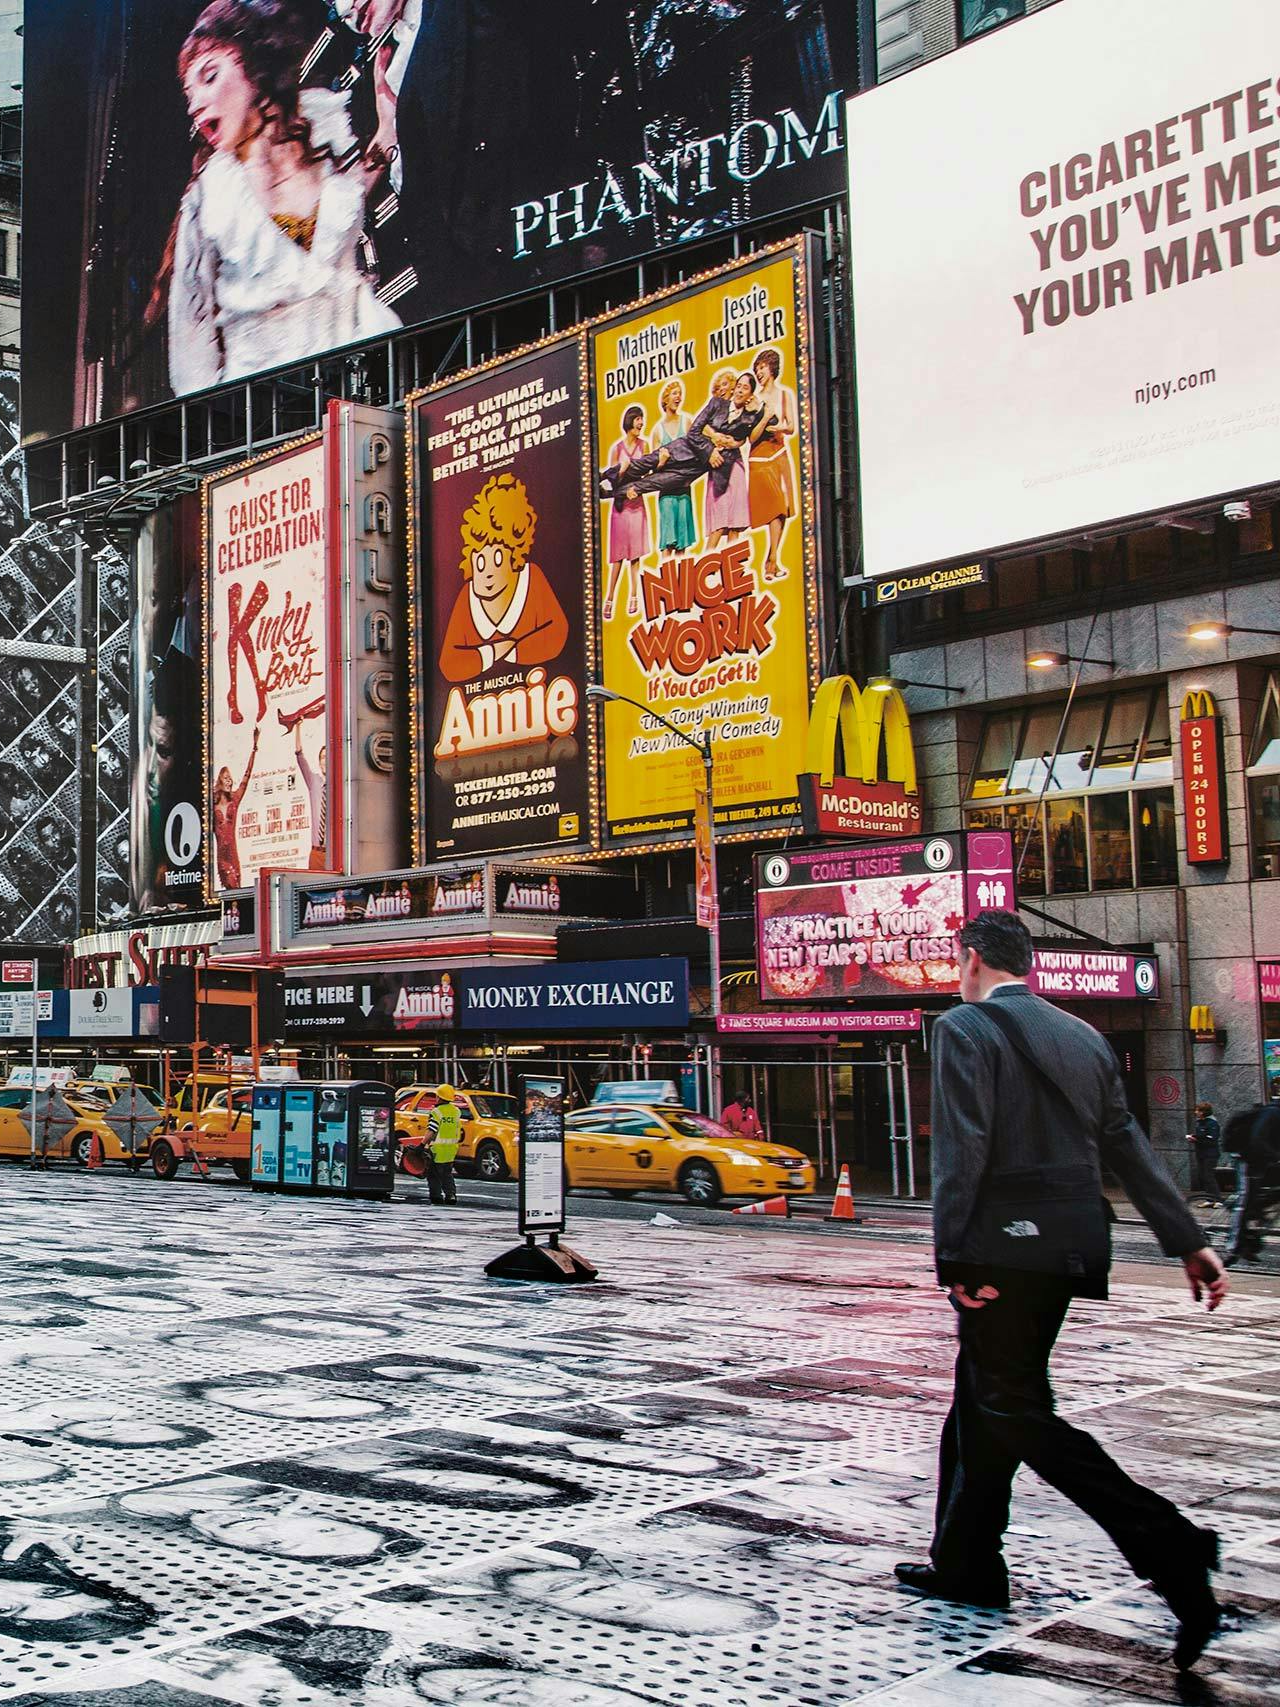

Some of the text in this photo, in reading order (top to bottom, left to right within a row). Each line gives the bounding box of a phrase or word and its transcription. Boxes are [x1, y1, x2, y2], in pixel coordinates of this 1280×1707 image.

[510, 89, 844, 260] PHANTOM
[1030, 172, 1192, 272] YOU'VE
[724, 286, 767, 329] Jessie
[1013, 256, 1132, 336] YOUR
[618, 322, 680, 363] Matthew
[709, 308, 785, 362] MUELLER
[605, 341, 696, 400] BRODERICK
[1134, 367, 1217, 405] njoy.com
[477, 378, 544, 416] ULTIMATE
[428, 386, 570, 451] FEEL-GOOD MUSICAL
[453, 414, 542, 458] IS BACK AND
[432, 454, 479, 482] BETTER
[481, 437, 520, 464] THAN
[229, 477, 311, 536] CAUSE FOR
[640, 540, 756, 621] NICE
[929, 574, 983, 591] SPECTACOLOR
[363, 432, 395, 774] PALACE
[227, 580, 313, 725] Kinky
[630, 594, 777, 677] WORK
[266, 643, 324, 693] Boots
[465, 672, 524, 694] THE MUSICAL
[648, 661, 758, 700] If You Can Get It
[434, 666, 579, 759] Annie
[641, 696, 769, 731] The Tony-Winning
[630, 716, 781, 758] New Musicl Comedy
[1191, 727, 1204, 775] OPEN
[454, 766, 557, 794] TICKETMASTER.COM
[1190, 778, 1209, 791] 24
[451, 802, 560, 829] ANNIETHEMUSICAL.COM
[455, 795, 469, 808] OR
[821, 794, 920, 820] McDonald's
[838, 817, 904, 832] Restaurant
[1194, 794, 1208, 855] HOURS
[164, 869, 202, 886] lifetime
[811, 857, 902, 881] COME INSIDE
[303, 898, 346, 926] Annie
[365, 890, 411, 919] Annie
[433, 881, 483, 914] Annie
[504, 882, 561, 912] Annie
[792, 909, 928, 941] PRACTICE YOUR
[767, 935, 958, 968] NEW YEAR'S EVE KISS!
[1038, 951, 1127, 972] VISITOR CENTER
[284, 985, 355, 1006] FICE HERE
[467, 981, 675, 1009] MONEY EXCHANGE
[1036, 971, 1120, 994] TIMES SQUARE
[393, 985, 454, 1019] Annie
[729, 1016, 906, 1029] TIMES SQUARE MUSEUM AND VISITOR CENTER
[253, 1143, 264, 1174] 1
[297, 1163, 311, 1177] TV
